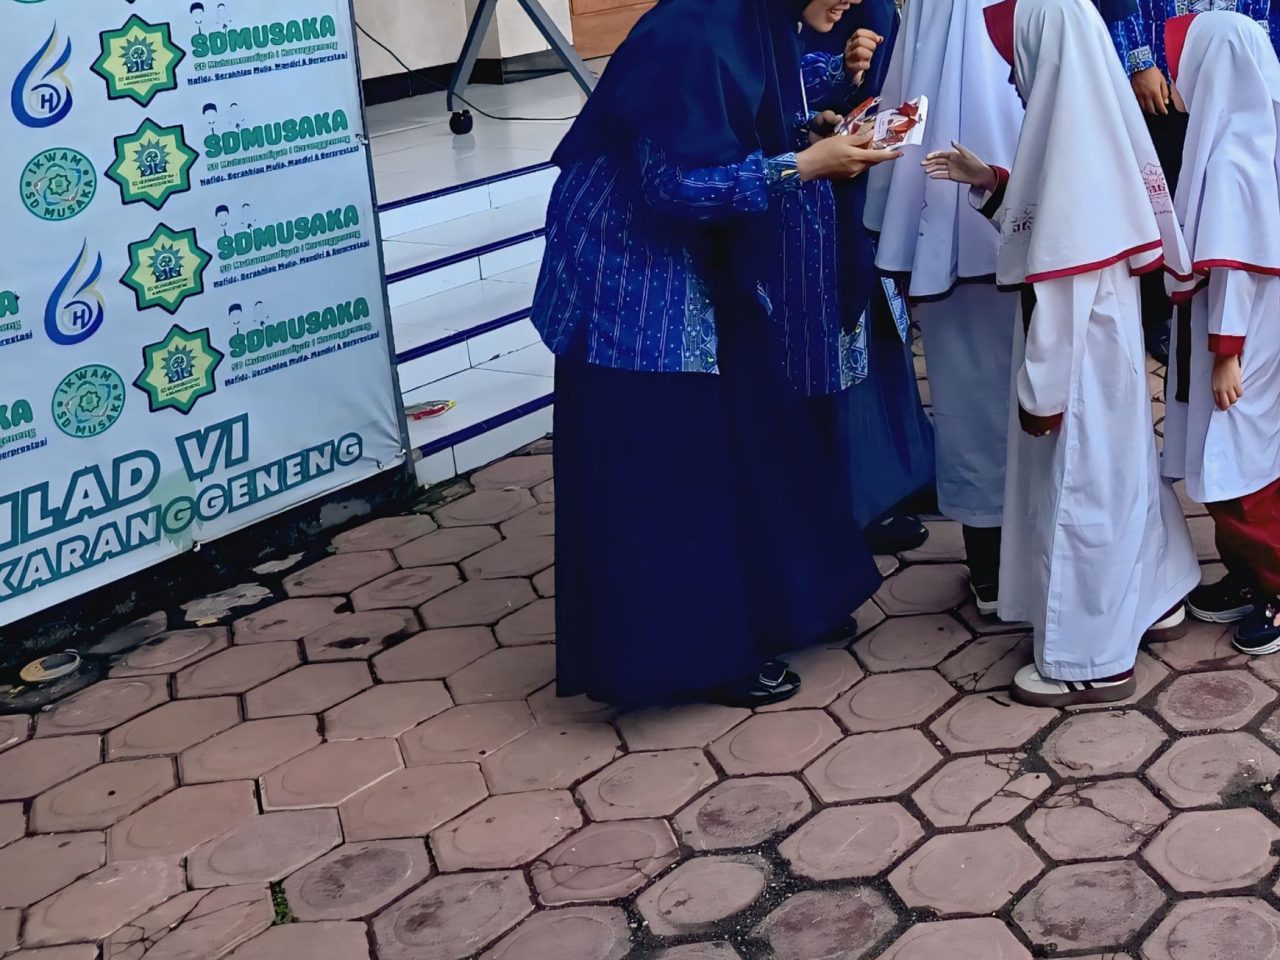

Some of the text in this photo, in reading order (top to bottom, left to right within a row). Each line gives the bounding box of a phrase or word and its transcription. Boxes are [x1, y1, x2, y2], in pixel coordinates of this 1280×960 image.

[191, 15, 335, 58] SDMUSAKA
[204, 109, 348, 158] SDMUSAKA
[28, 152, 82, 175] IKWAM
[26, 180, 93, 218] SD MUSAKA
[217, 204, 359, 261] SDMUSAKA
[229, 296, 369, 358] SDMUSAKA
[60, 369, 112, 394] IKWAM
[57, 393, 122, 435] SD MUSAKA
[175, 413, 249, 481] VI
[0, 432, 363, 601] KARANGGENENG
